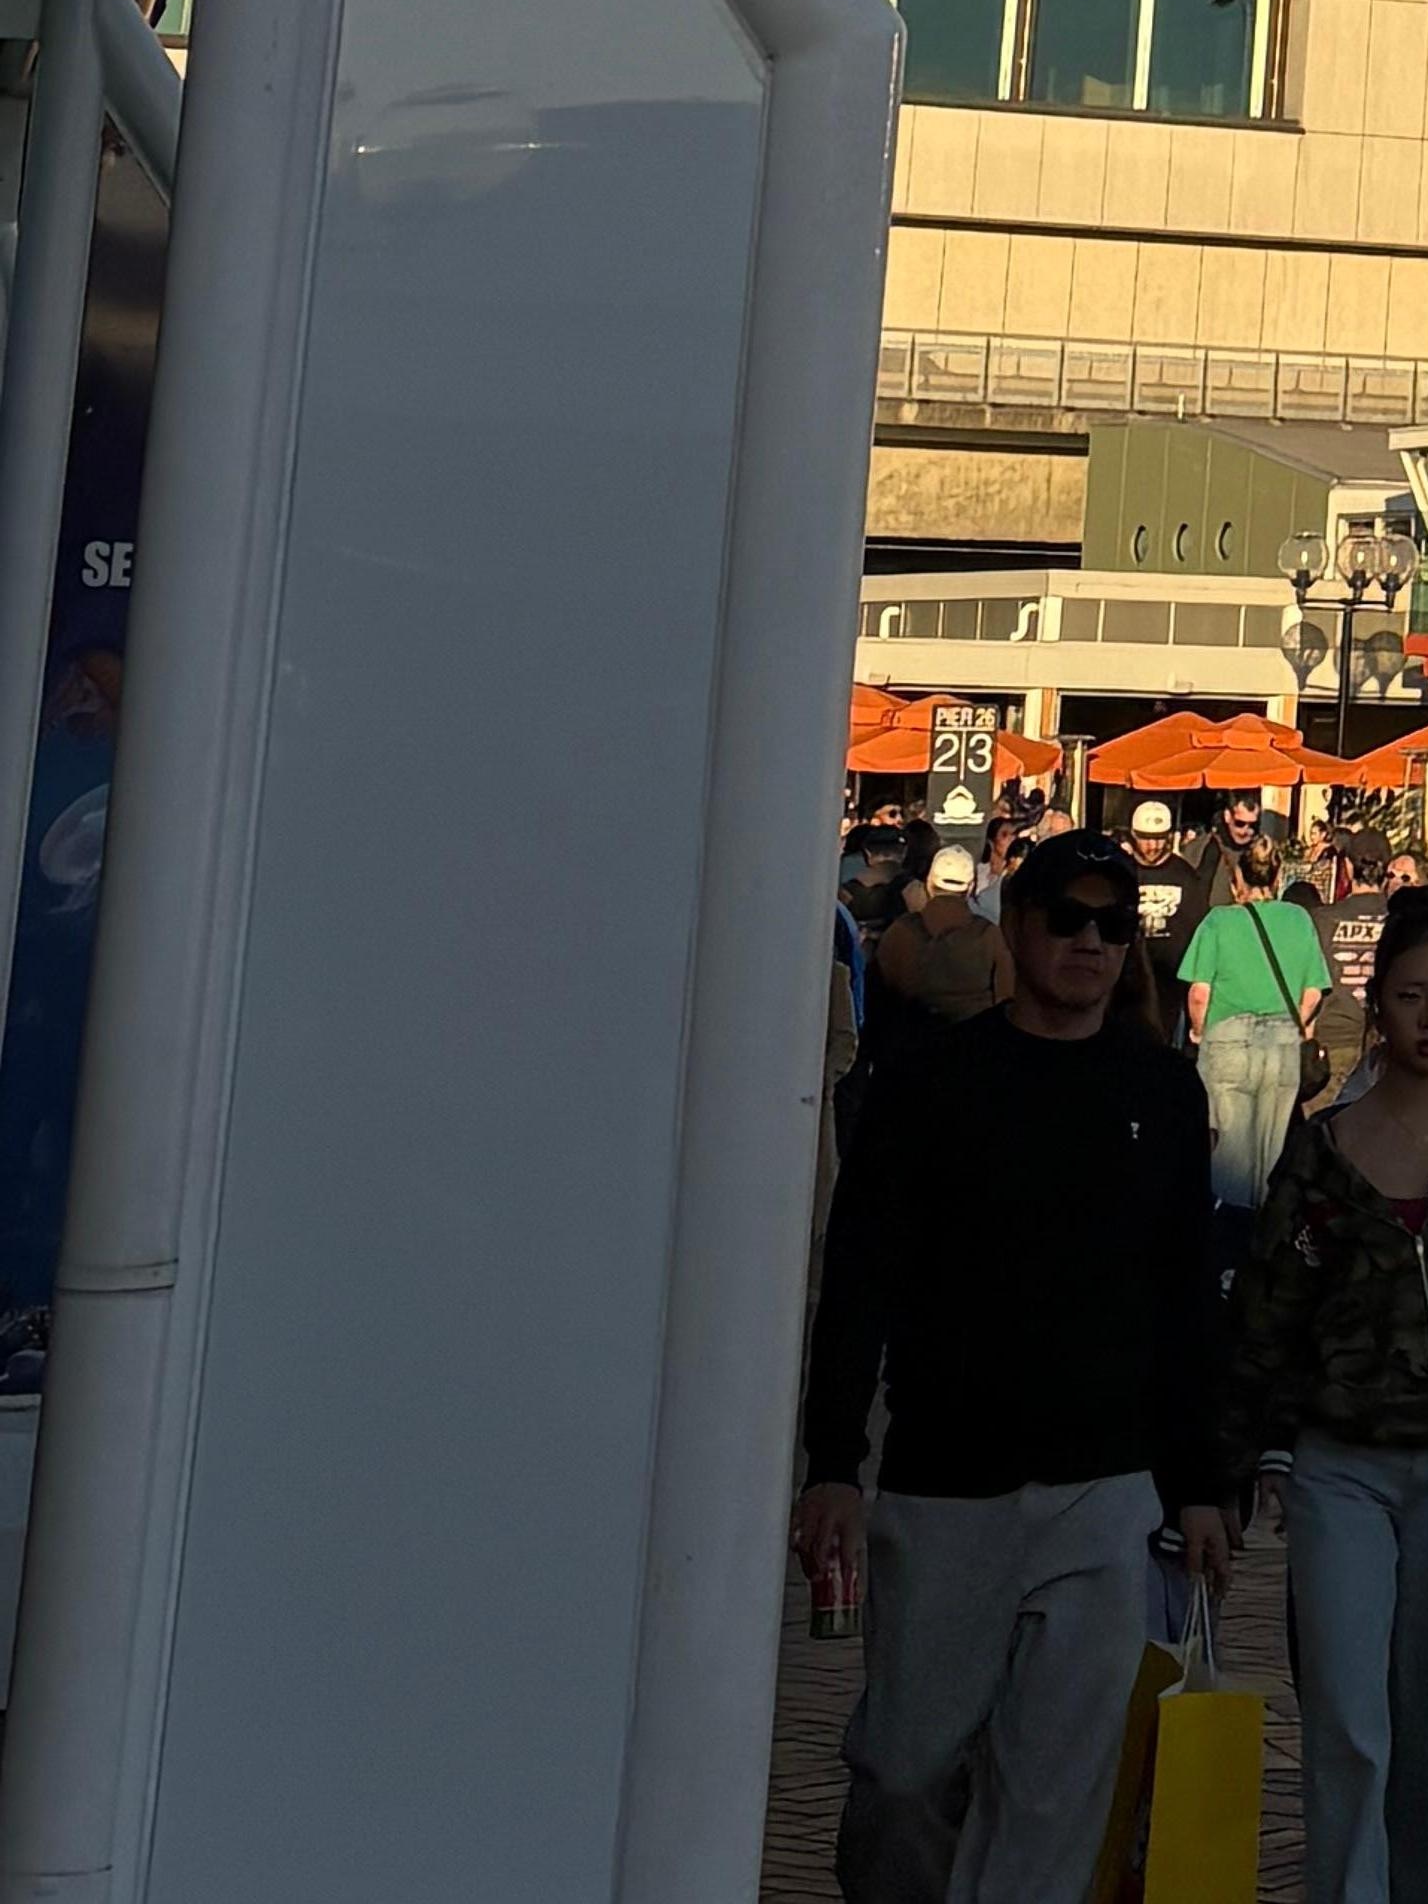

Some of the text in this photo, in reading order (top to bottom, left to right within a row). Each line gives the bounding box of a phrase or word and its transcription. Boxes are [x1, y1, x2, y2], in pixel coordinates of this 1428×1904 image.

[935, 707, 996, 728] PIER 26
[933, 733, 993, 773] 2 3
